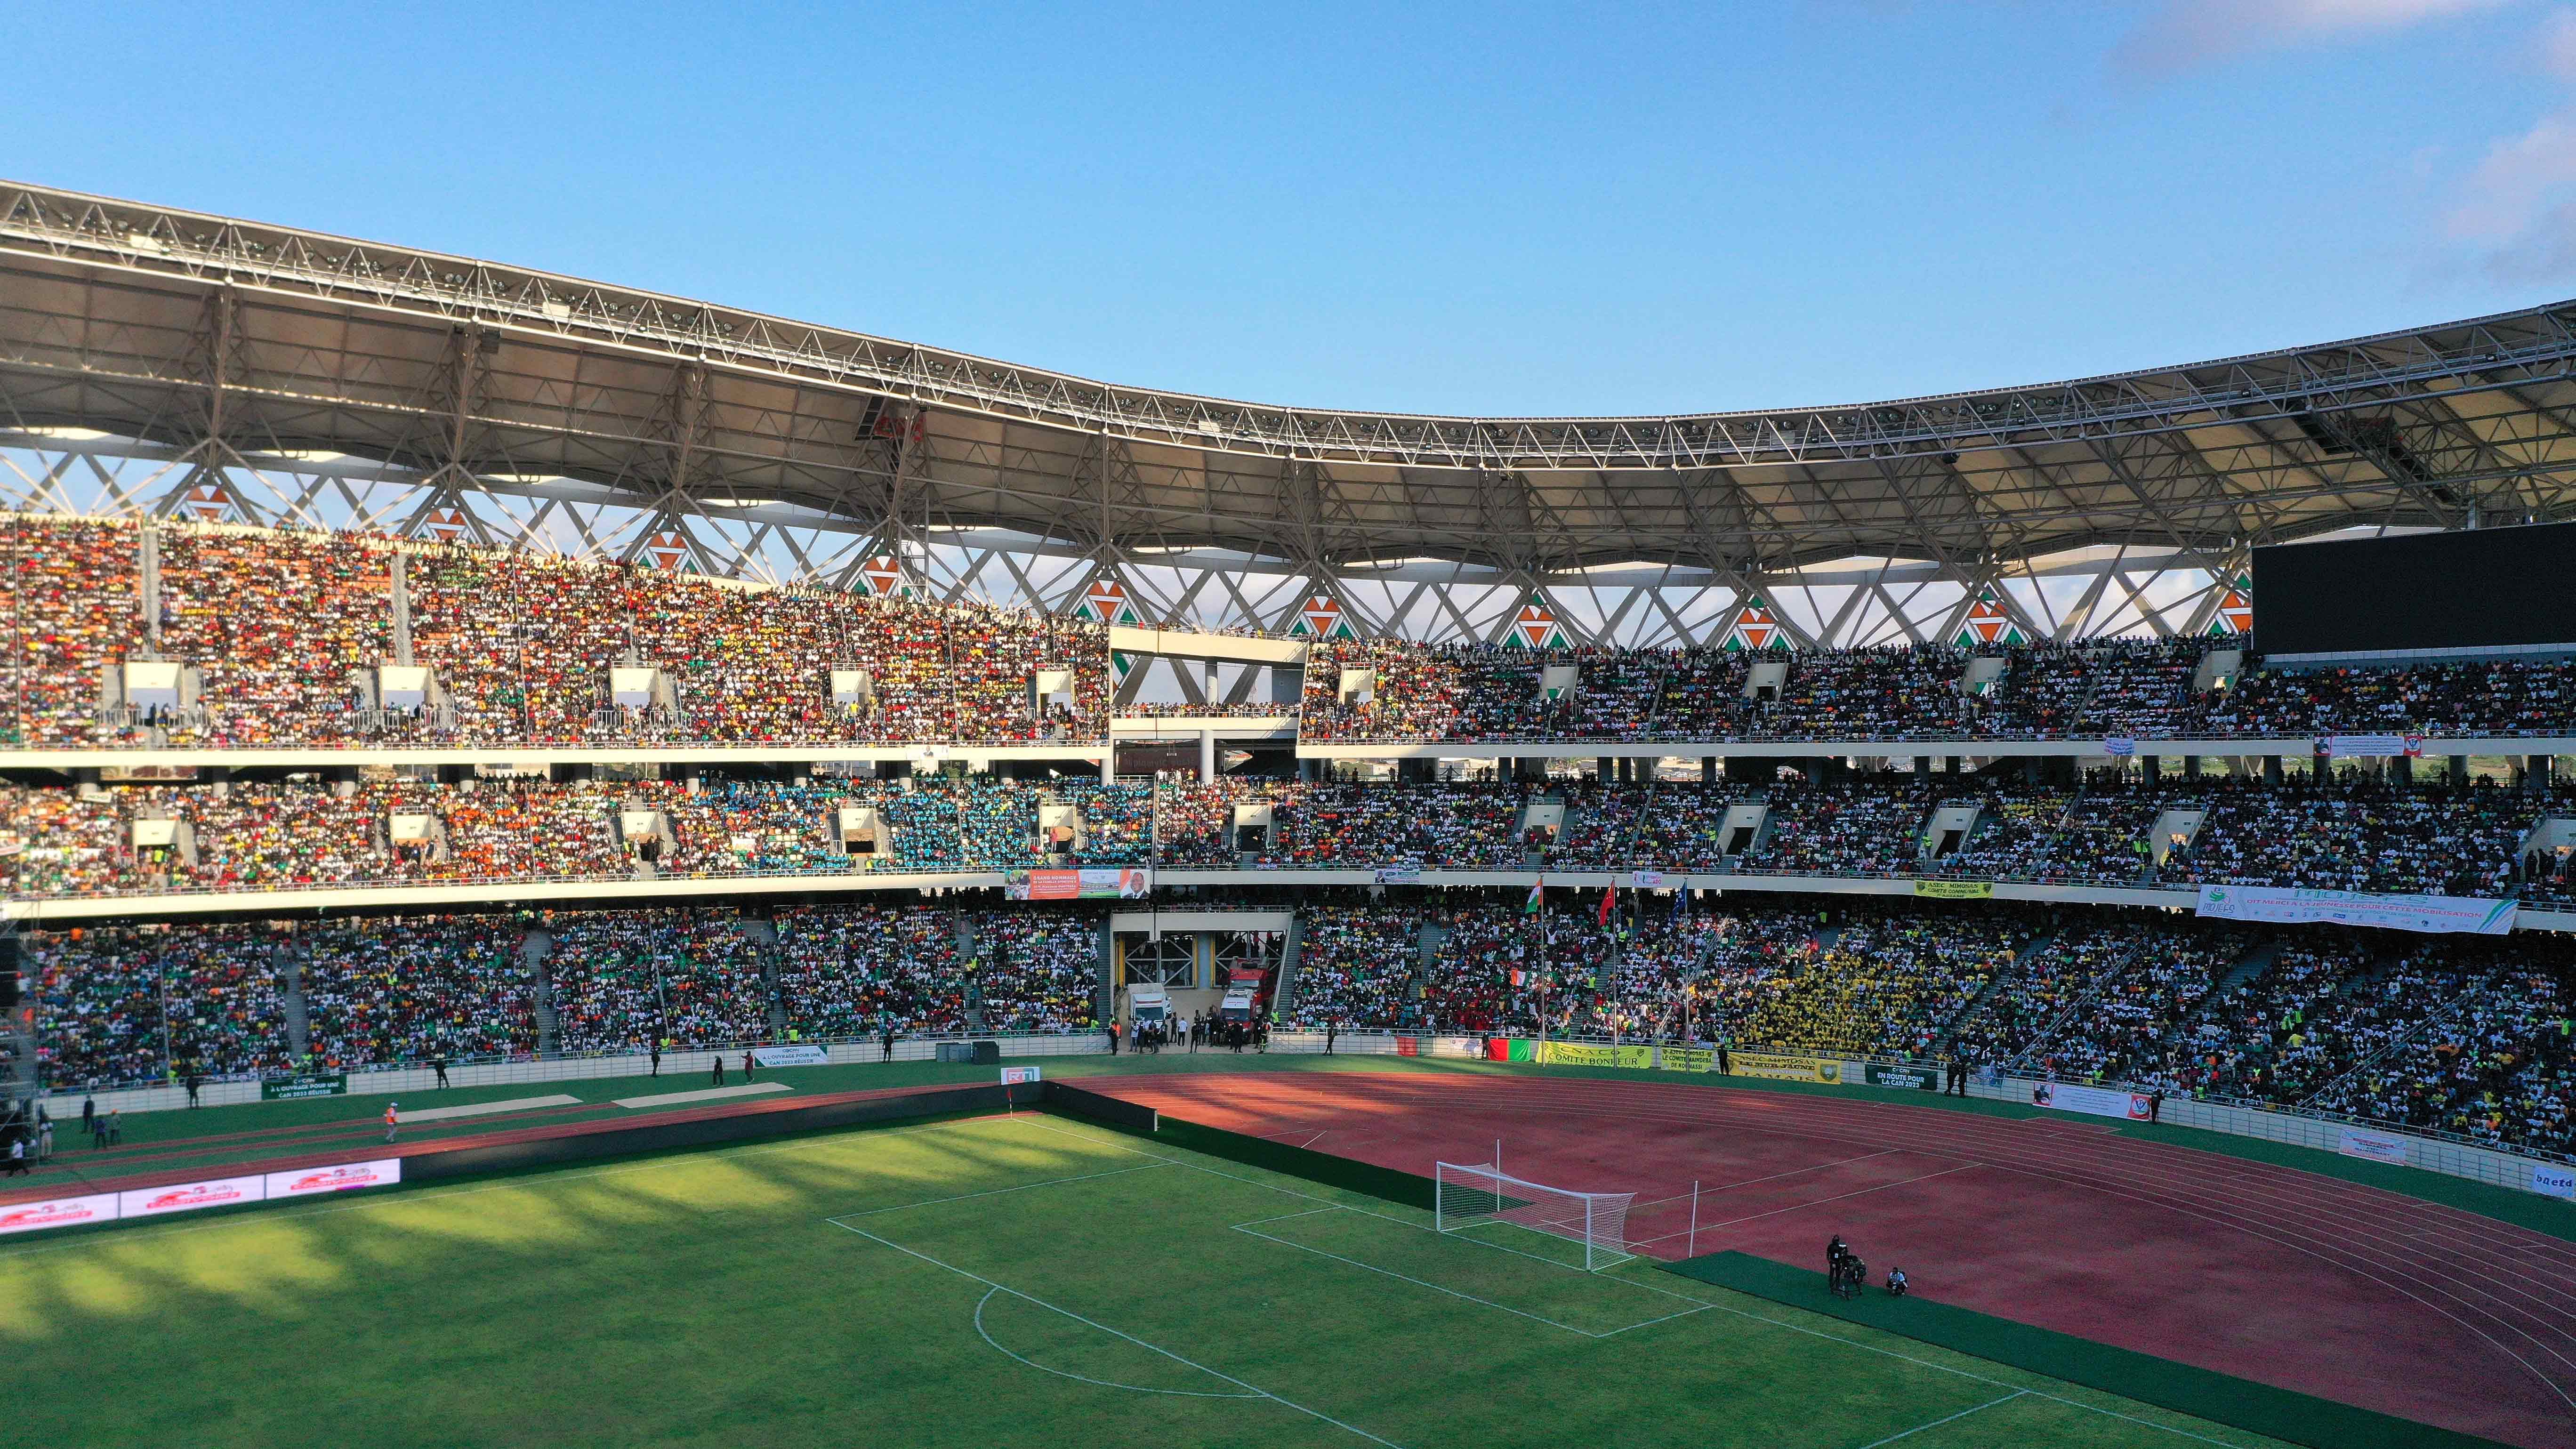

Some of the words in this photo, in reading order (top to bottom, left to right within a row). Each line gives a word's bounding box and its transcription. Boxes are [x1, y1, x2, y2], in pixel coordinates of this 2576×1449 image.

[2294, 889, 2428, 903] MOJS
[2203, 902, 2235, 913] MOJEFS
[2413, 908, 2483, 918] MOBILISATION
[1009, 1071, 1033, 1082] RTI
[2536, 1175, 2573, 1187] bnetd
